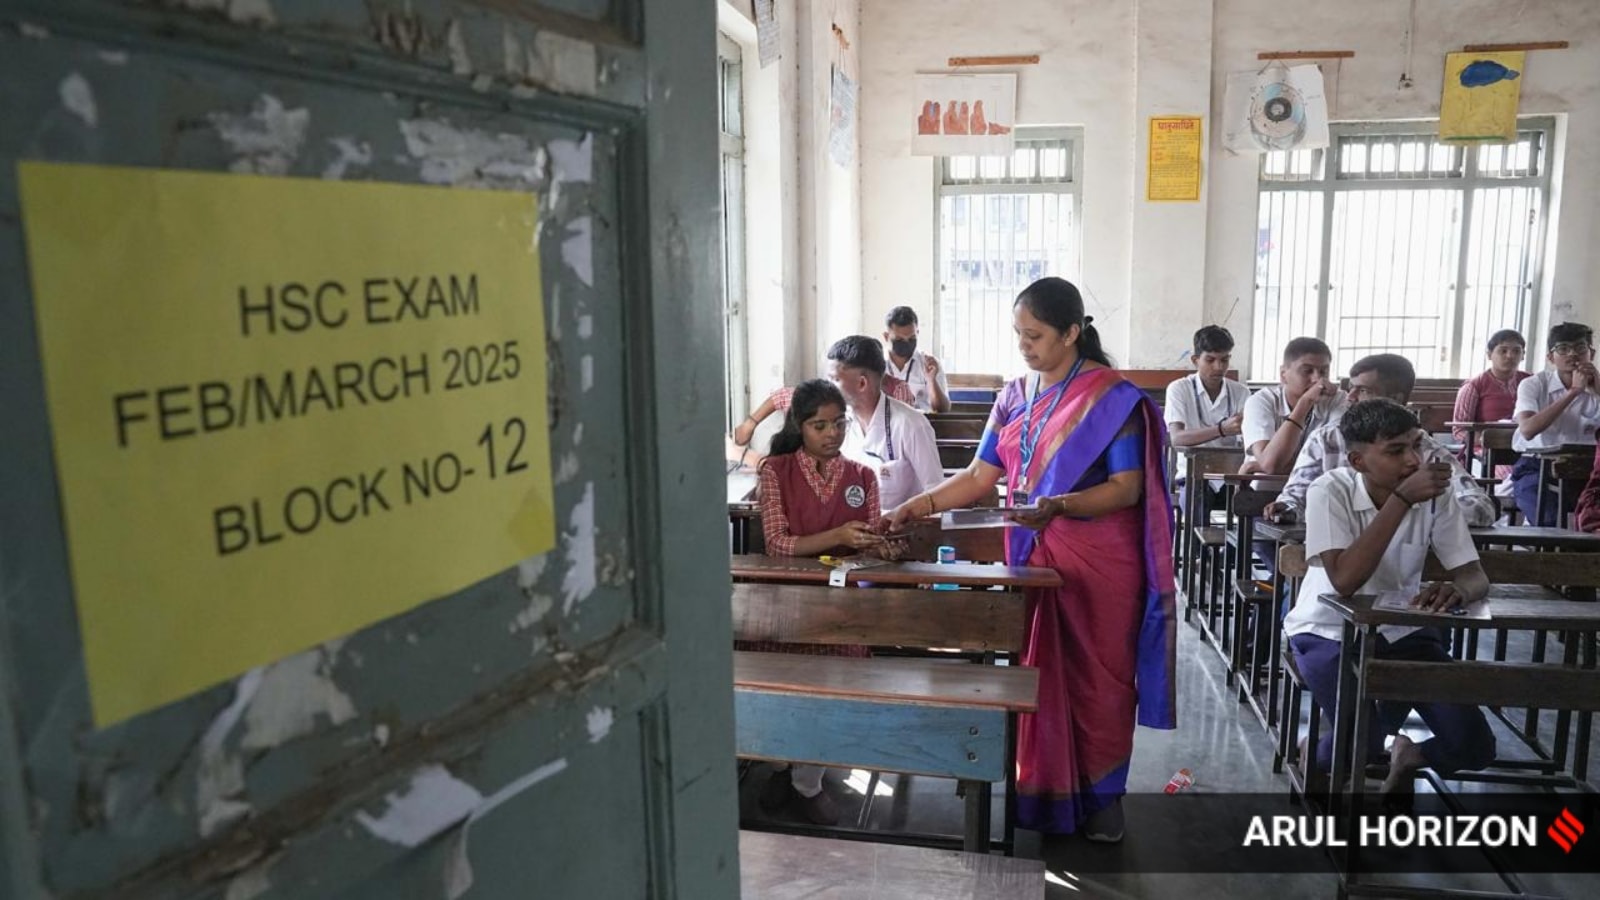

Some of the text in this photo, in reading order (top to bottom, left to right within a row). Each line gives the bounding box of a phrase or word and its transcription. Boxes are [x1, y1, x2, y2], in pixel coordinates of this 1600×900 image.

[239, 273, 480, 336] HSC EXAM
[112, 340, 522, 449] FEB/MARCH 2025
[213, 417, 528, 557] BLOCK NO-12
